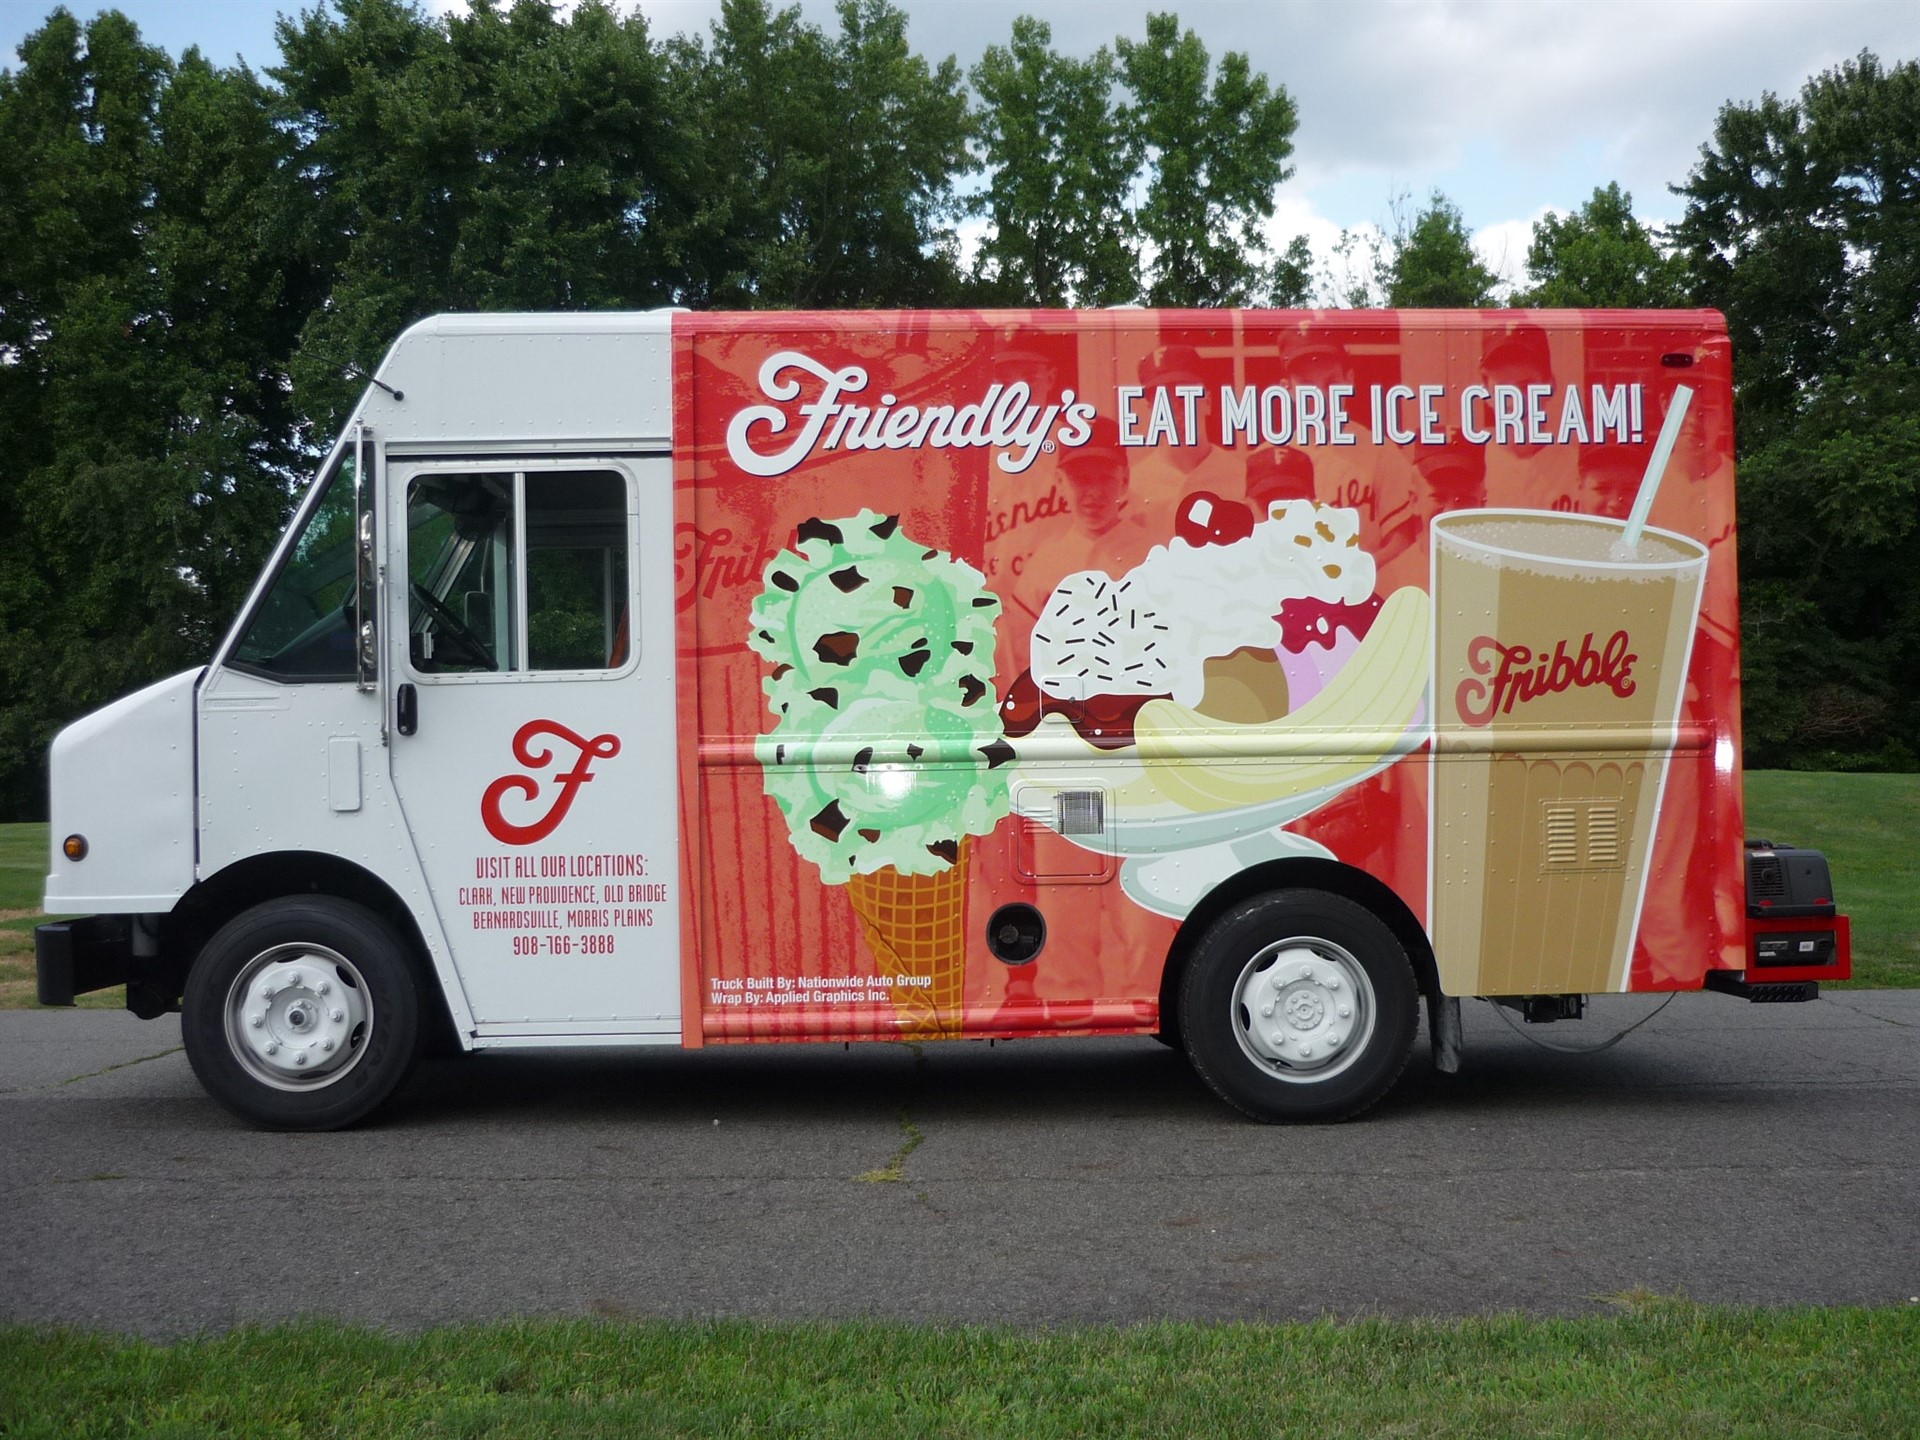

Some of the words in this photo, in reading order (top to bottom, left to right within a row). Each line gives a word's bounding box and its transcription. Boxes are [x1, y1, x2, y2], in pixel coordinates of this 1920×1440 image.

[727, 351, 1096, 477] Friendly's
[1117, 385, 1204, 446] EAT
[1220, 384, 1357, 446] MORE
[1370, 384, 1446, 445] ICE
[1460, 383, 1644, 445] CREAM!
[1455, 629, 1638, 728] Fribble
[481, 719, 621, 845] F
[476, 856, 511, 879] VISIT
[515, 855, 538, 878] ALL
[541, 855, 567, 878] OUR
[570, 853, 649, 877] LOCATIONS:
[459, 886, 497, 907] CLARK,
[501, 885, 526, 905] NEW
[529, 884, 600, 905] PROVIDENCE,
[604, 884, 624, 903] OLD
[628, 883, 667, 902] BRIDGE
[473, 909, 563, 930] BERNARDSVILLE,
[567, 908, 609, 928] MORRIS
[614, 907, 653, 927] PLAINS
[513, 934, 615, 956] 908-766-3888
[711, 977, 744, 990] Truck
[747, 977, 774, 990] Built
[777, 977, 796, 992] By:
[798, 976, 864, 989] Nationwide
[866, 975, 893, 988] Auto
[896, 975, 932, 988] Group
[711, 992, 743, 1005] Wrap
[745, 991, 764, 1005] By:
[765, 989, 810, 1004] Applied
[813, 988, 865, 1004] Graphics
[868, 988, 890, 1001] Inc.
